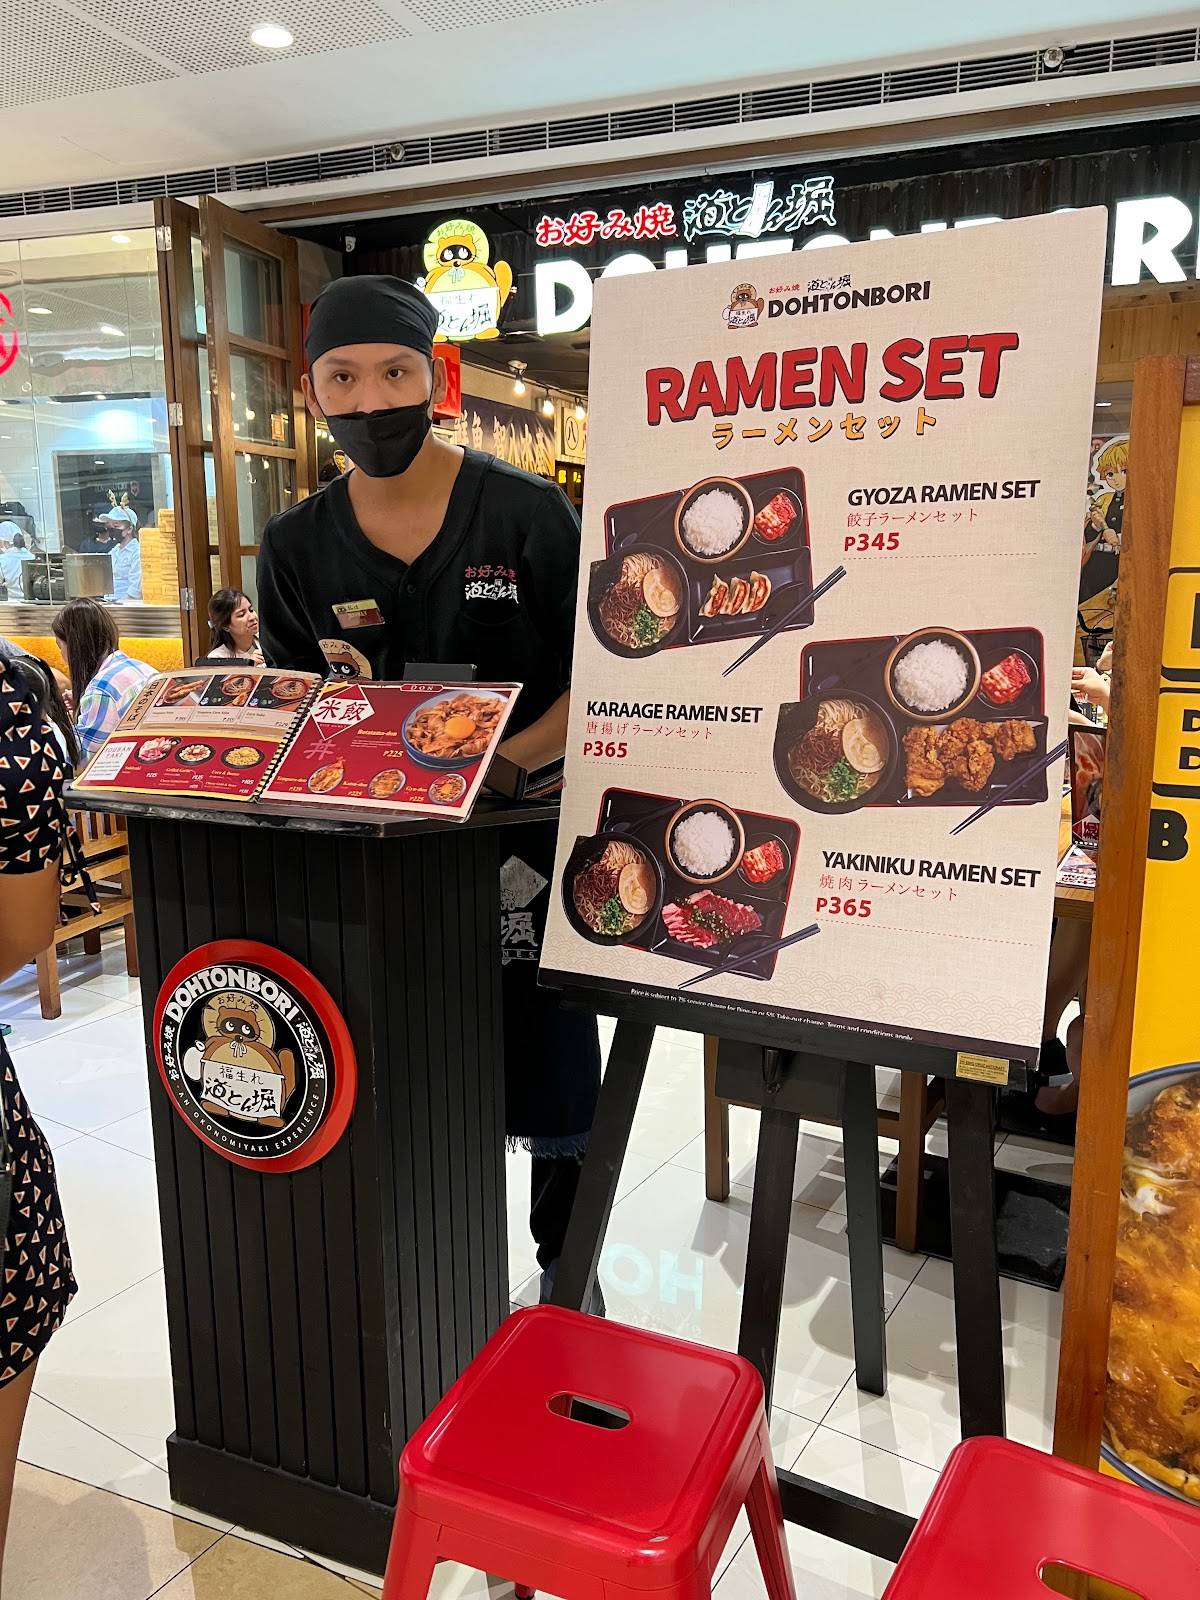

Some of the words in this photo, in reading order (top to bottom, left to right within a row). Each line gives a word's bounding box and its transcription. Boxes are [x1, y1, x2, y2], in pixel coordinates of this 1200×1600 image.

[536, 202, 677, 247] お好み焼
[768, 283, 801, 294] お好み焼
[768, 280, 931, 319] DOHTONBORI
[645, 342, 868, 427] RAMEN
[880, 332, 1019, 400] SET
[711, 407, 938, 450] ラーメンセット
[847, 486, 917, 506] GYOZA
[921, 482, 997, 503] RAMEN
[1001, 479, 1041, 500] SET
[847, 508, 979, 528] 餃子ラーメンセット
[844, 532, 900, 552] P345
[409, 684, 435, 692] DON
[314, 699, 369, 721] 米飯
[586, 700, 663, 720] KARAAGE
[665, 703, 728, 723] RAMEN
[730, 706, 764, 724] SET
[585, 721, 713, 741] 唐揚げラーメンセット
[583, 740, 628, 759] P365
[822, 850, 915, 876] YAKINIKU
[918, 859, 997, 885] RAMEN
[1000, 867, 1042, 889] SET
[818, 873, 958, 902] 焼肉ラーメンセット
[816, 896, 872, 918] P365
[165, 968, 299, 1023] DOHTONBORI
[217, 993, 260, 1012] お好み焼
[219, 1065, 265, 1086] 福生れ
[202, 1076, 279, 1116] 道とん堀
[178, 1092, 190, 1106] AN
[193, 1111, 269, 1153] OKONOMIYAKI
[275, 1093, 320, 1150] EXPERIENCE
